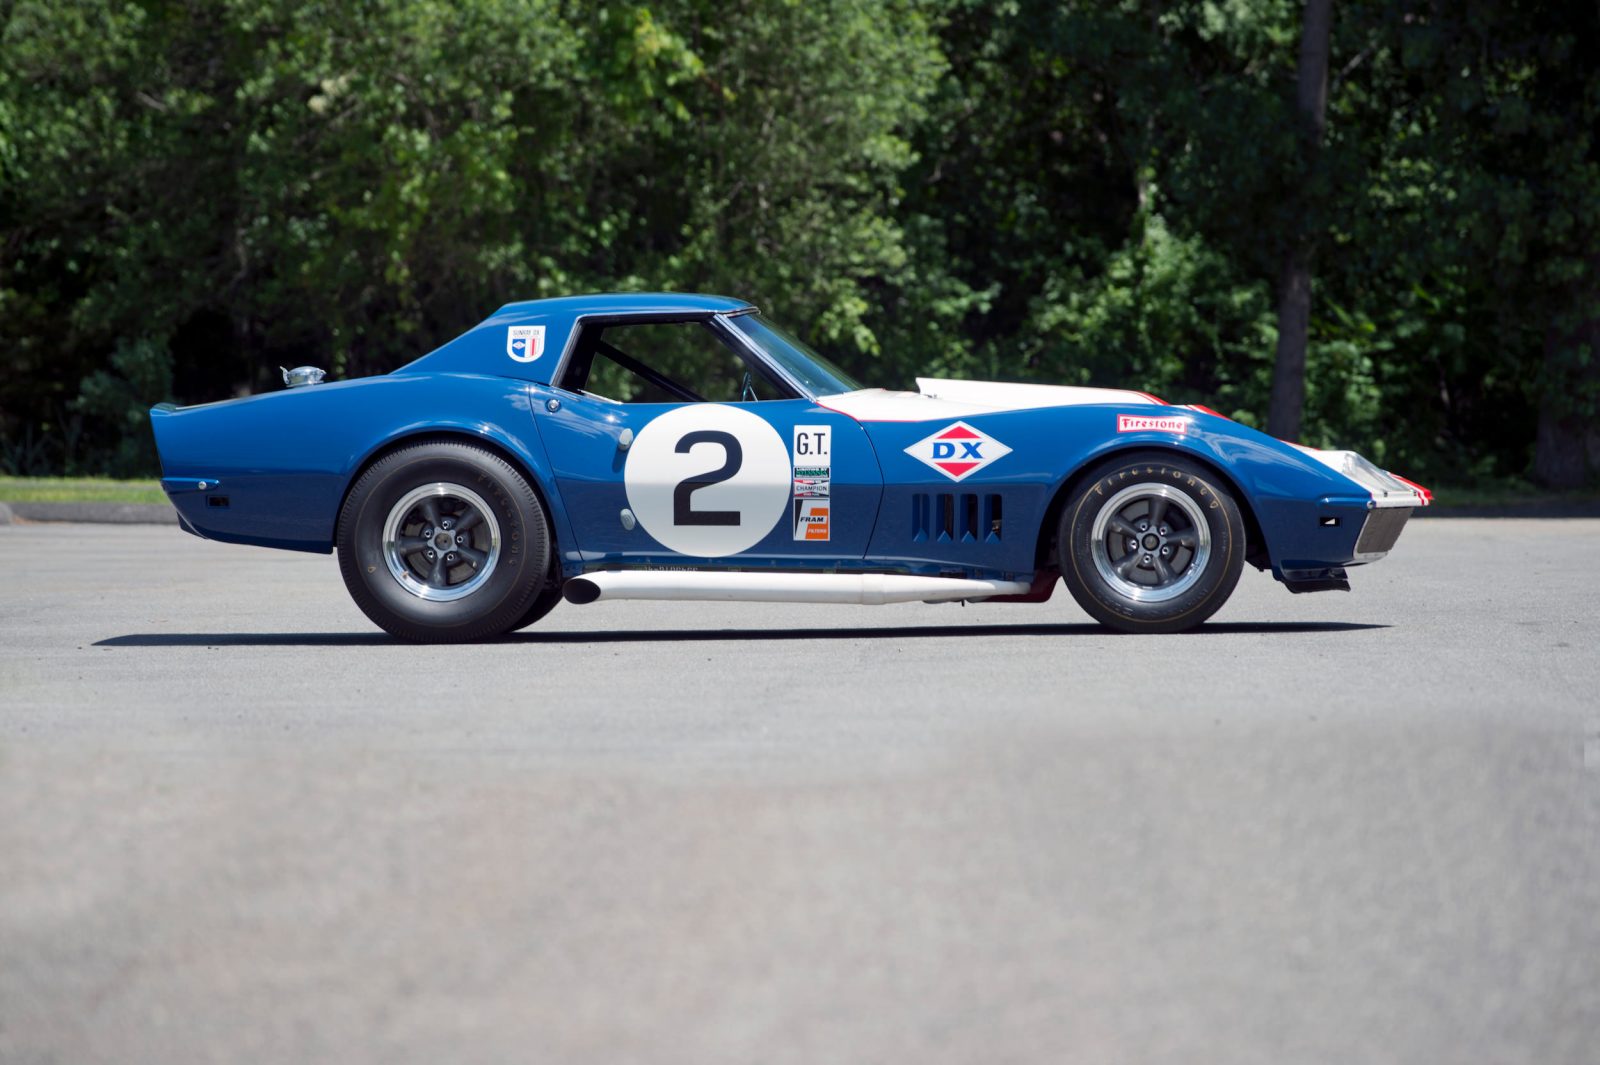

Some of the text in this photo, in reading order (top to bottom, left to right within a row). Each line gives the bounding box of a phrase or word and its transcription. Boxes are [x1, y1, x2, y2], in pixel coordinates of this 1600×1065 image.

[1122, 418, 1183, 429] Firestone
[796, 432, 828, 455] G.T.
[931, 442, 984, 459] DX
[673, 430, 743, 526] 2
